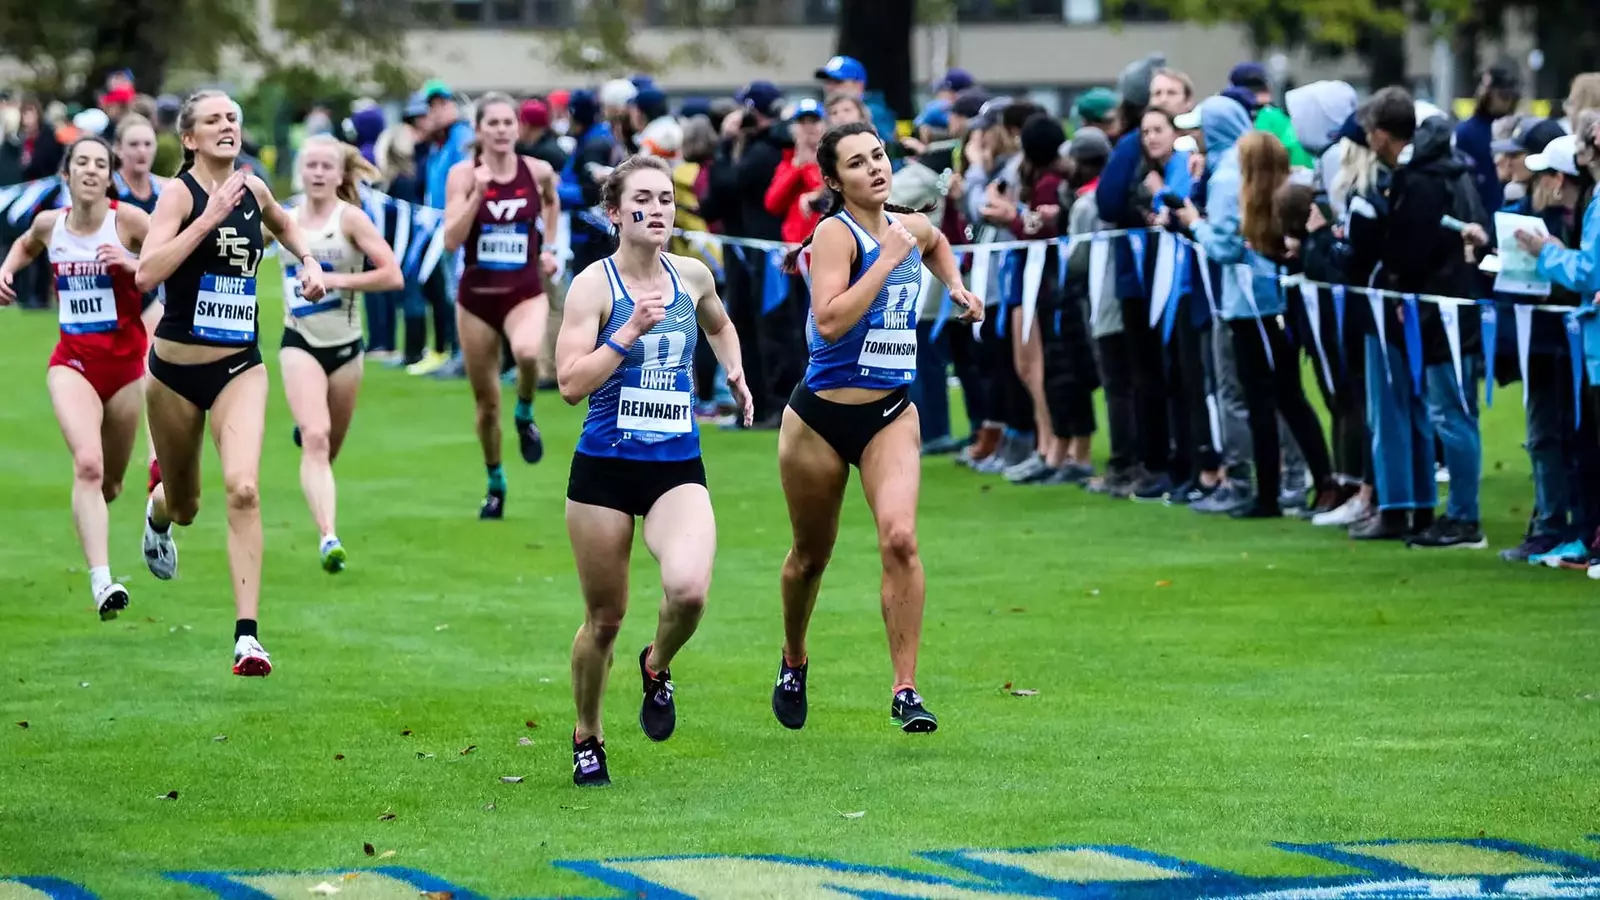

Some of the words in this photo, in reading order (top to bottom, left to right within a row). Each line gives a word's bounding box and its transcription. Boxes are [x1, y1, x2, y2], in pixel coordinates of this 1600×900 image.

[486, 198, 528, 221] VT
[216, 226, 262, 277] FSU
[58, 262, 72, 276] NC
[74, 262, 107, 276] STATE
[214, 276, 247, 295] UNITE
[70, 297, 103, 314] HOLT
[197, 301, 254, 321] SKYRING
[883, 311, 909, 329] UNITE
[864, 340, 917, 356] TOMKINSON
[640, 369, 677, 391] UNITE
[620, 400, 690, 421] REINHART
